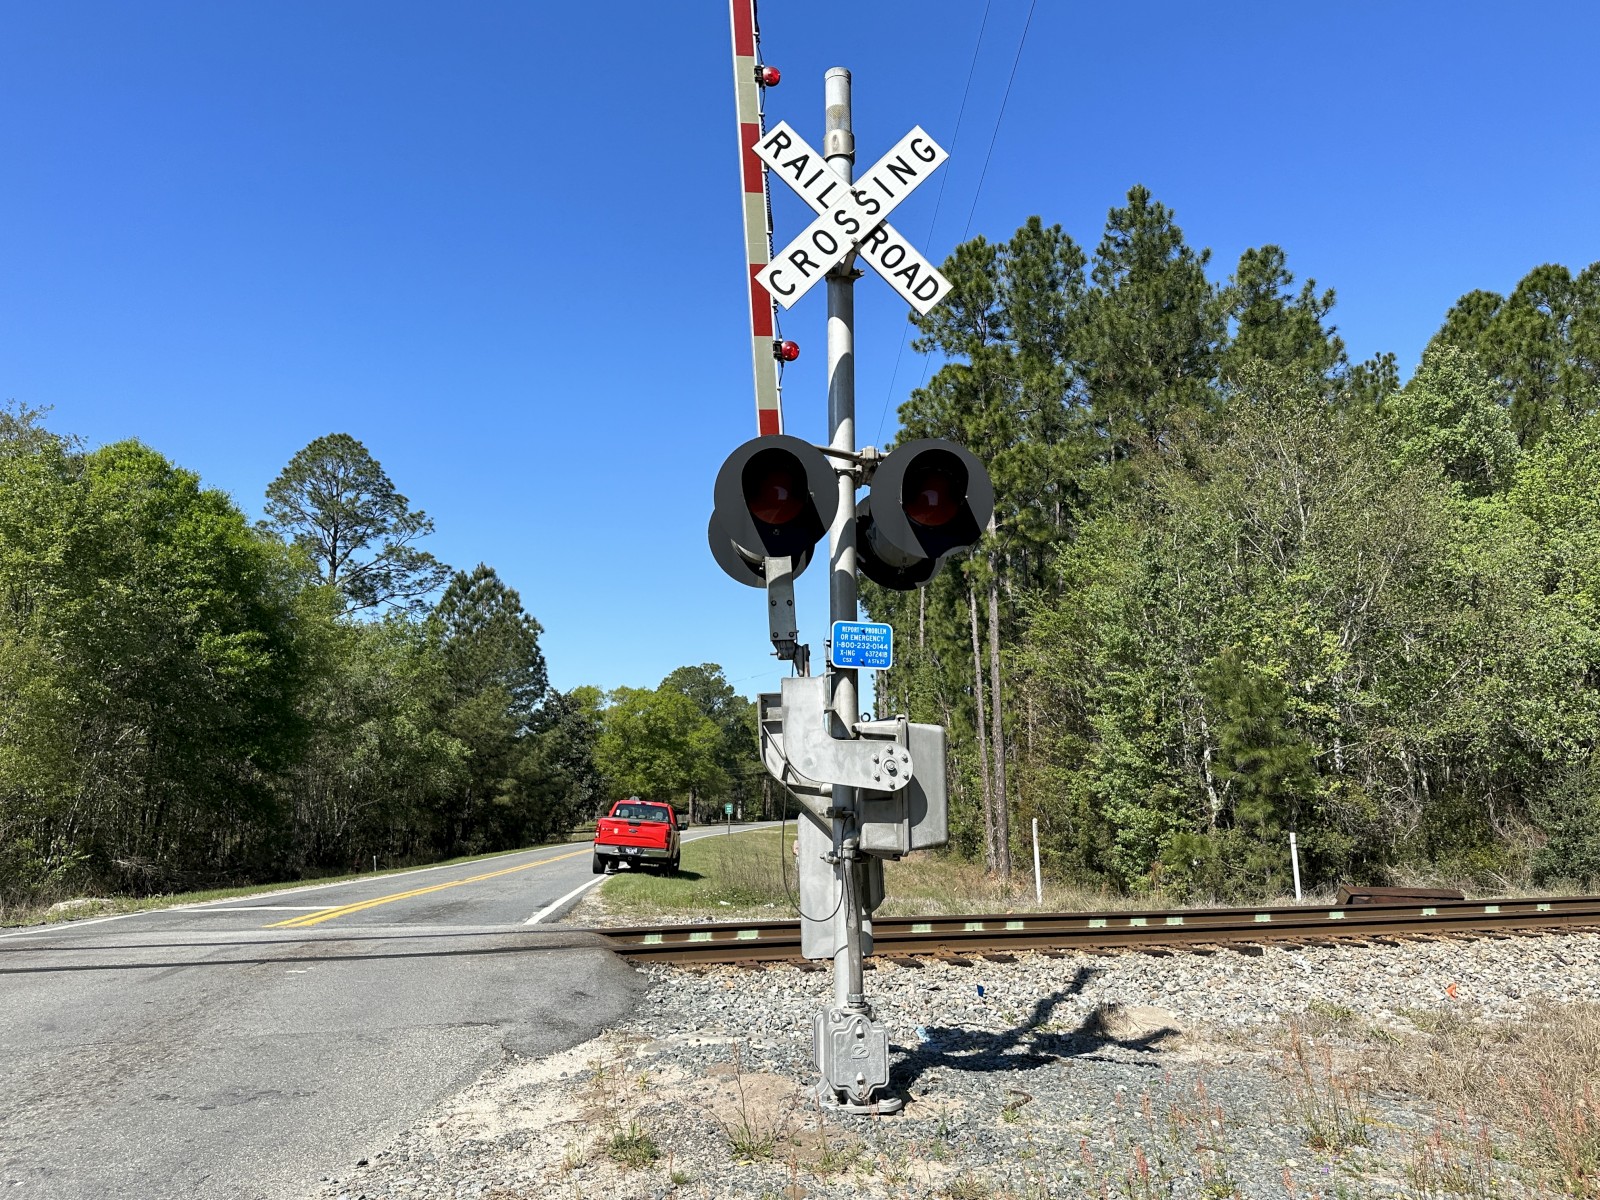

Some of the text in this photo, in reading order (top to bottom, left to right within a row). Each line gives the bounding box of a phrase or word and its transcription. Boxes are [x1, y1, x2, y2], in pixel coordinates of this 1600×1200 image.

[763, 130, 940, 302] RAIL ROAD
[769, 138, 937, 296] CROSSING
[865, 627, 887, 635] PROBLEM
[850, 634, 885, 642] EMERGENCY
[836, 641, 888, 650] 1-800-232-0144
